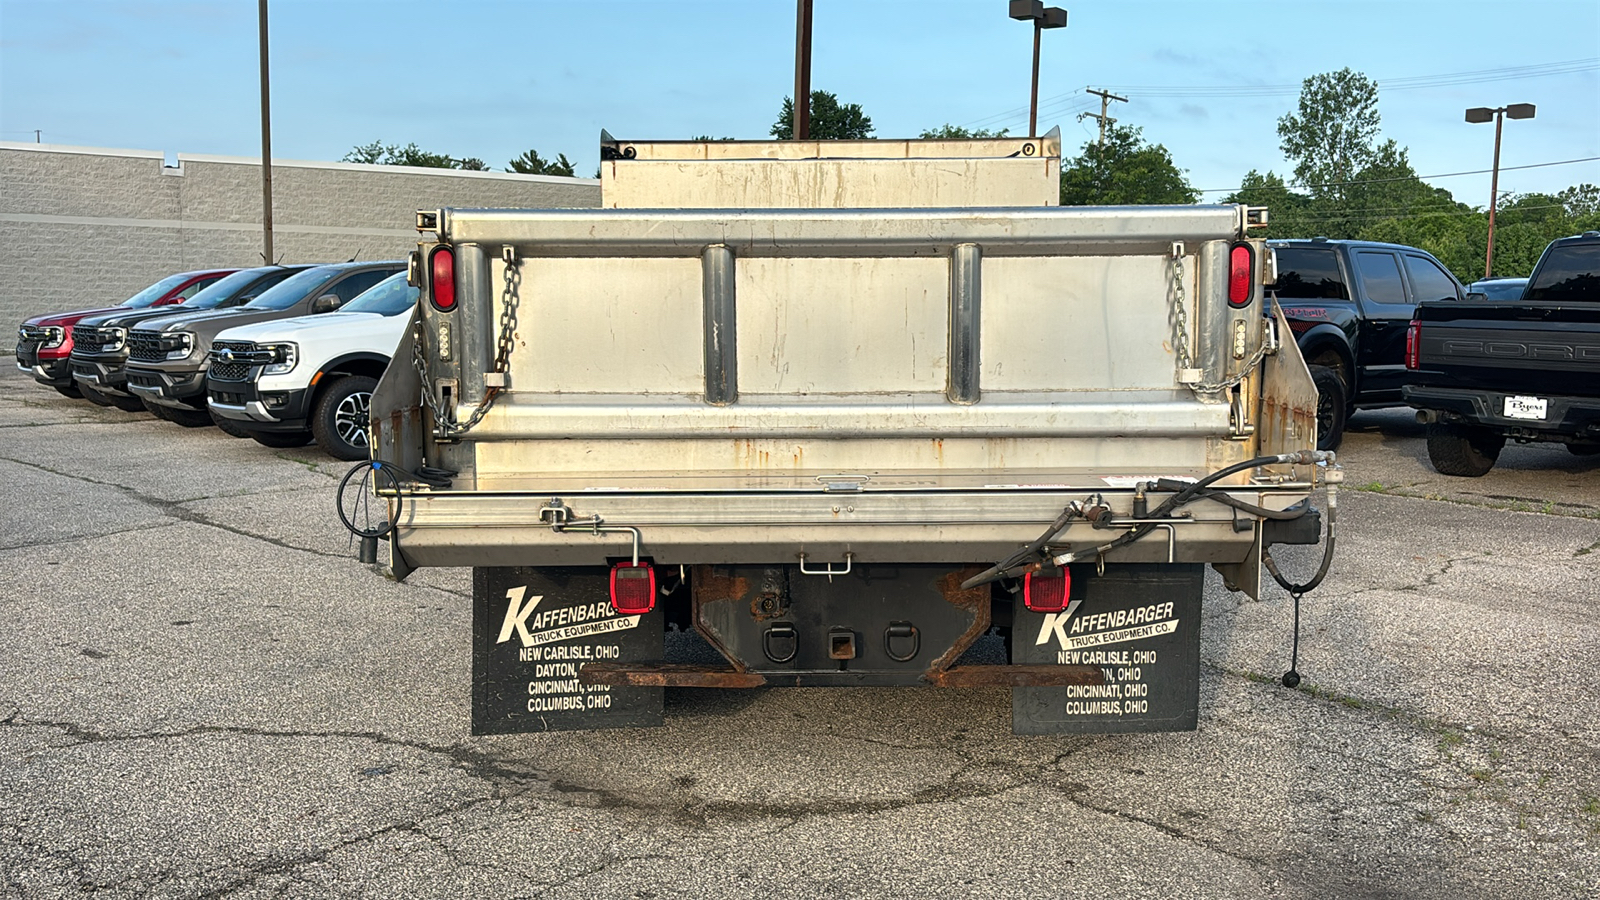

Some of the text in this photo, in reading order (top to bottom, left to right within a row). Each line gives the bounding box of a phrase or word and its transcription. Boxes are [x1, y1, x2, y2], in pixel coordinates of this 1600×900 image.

[496, 585, 617, 647] KAFFENBARG
[531, 618, 633, 644] TRUCK EQUIPMENT CO.
[1035, 600, 1174, 650] KAFFENBARGER
[1069, 623, 1171, 648] TRUCK EQUIPMENT CO.
[519, 645, 619, 662] NEW CARLISLE, OHIO
[1057, 650, 1157, 667] NEW CARLISLE, OHIO
[535, 662, 578, 679] DAYTON,
[1117, 667, 1141, 681] OHIO
[1066, 683, 1148, 699] CINCINNATI, OHIO
[527, 694, 611, 712] COLUMBUS, OHIO
[1066, 700, 1148, 716] COLUMBUS, OHIO
